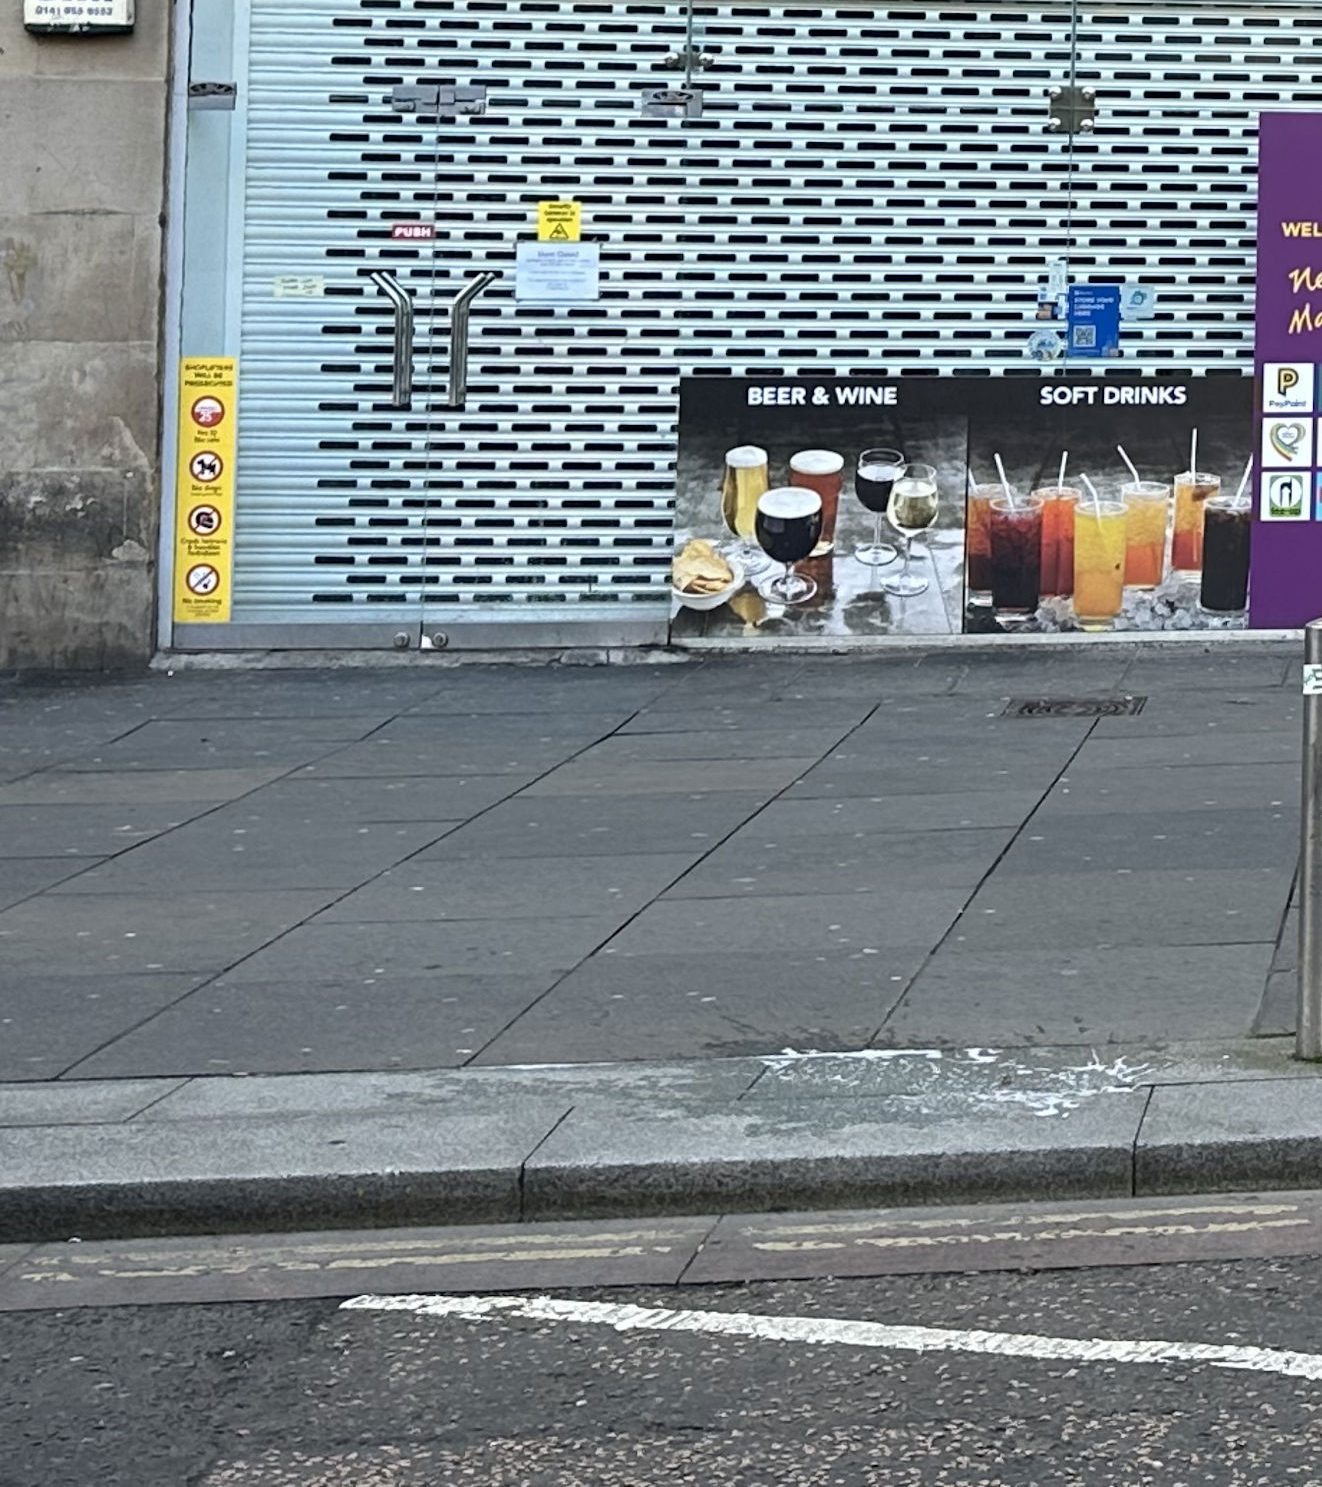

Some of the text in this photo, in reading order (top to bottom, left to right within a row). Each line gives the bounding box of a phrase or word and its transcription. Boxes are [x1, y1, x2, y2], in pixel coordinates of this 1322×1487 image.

[394, 227, 431, 237] PUSH
[747, 386, 898, 406] BEER & WINE
[1040, 386, 1187, 405] SOFT DRINKS
